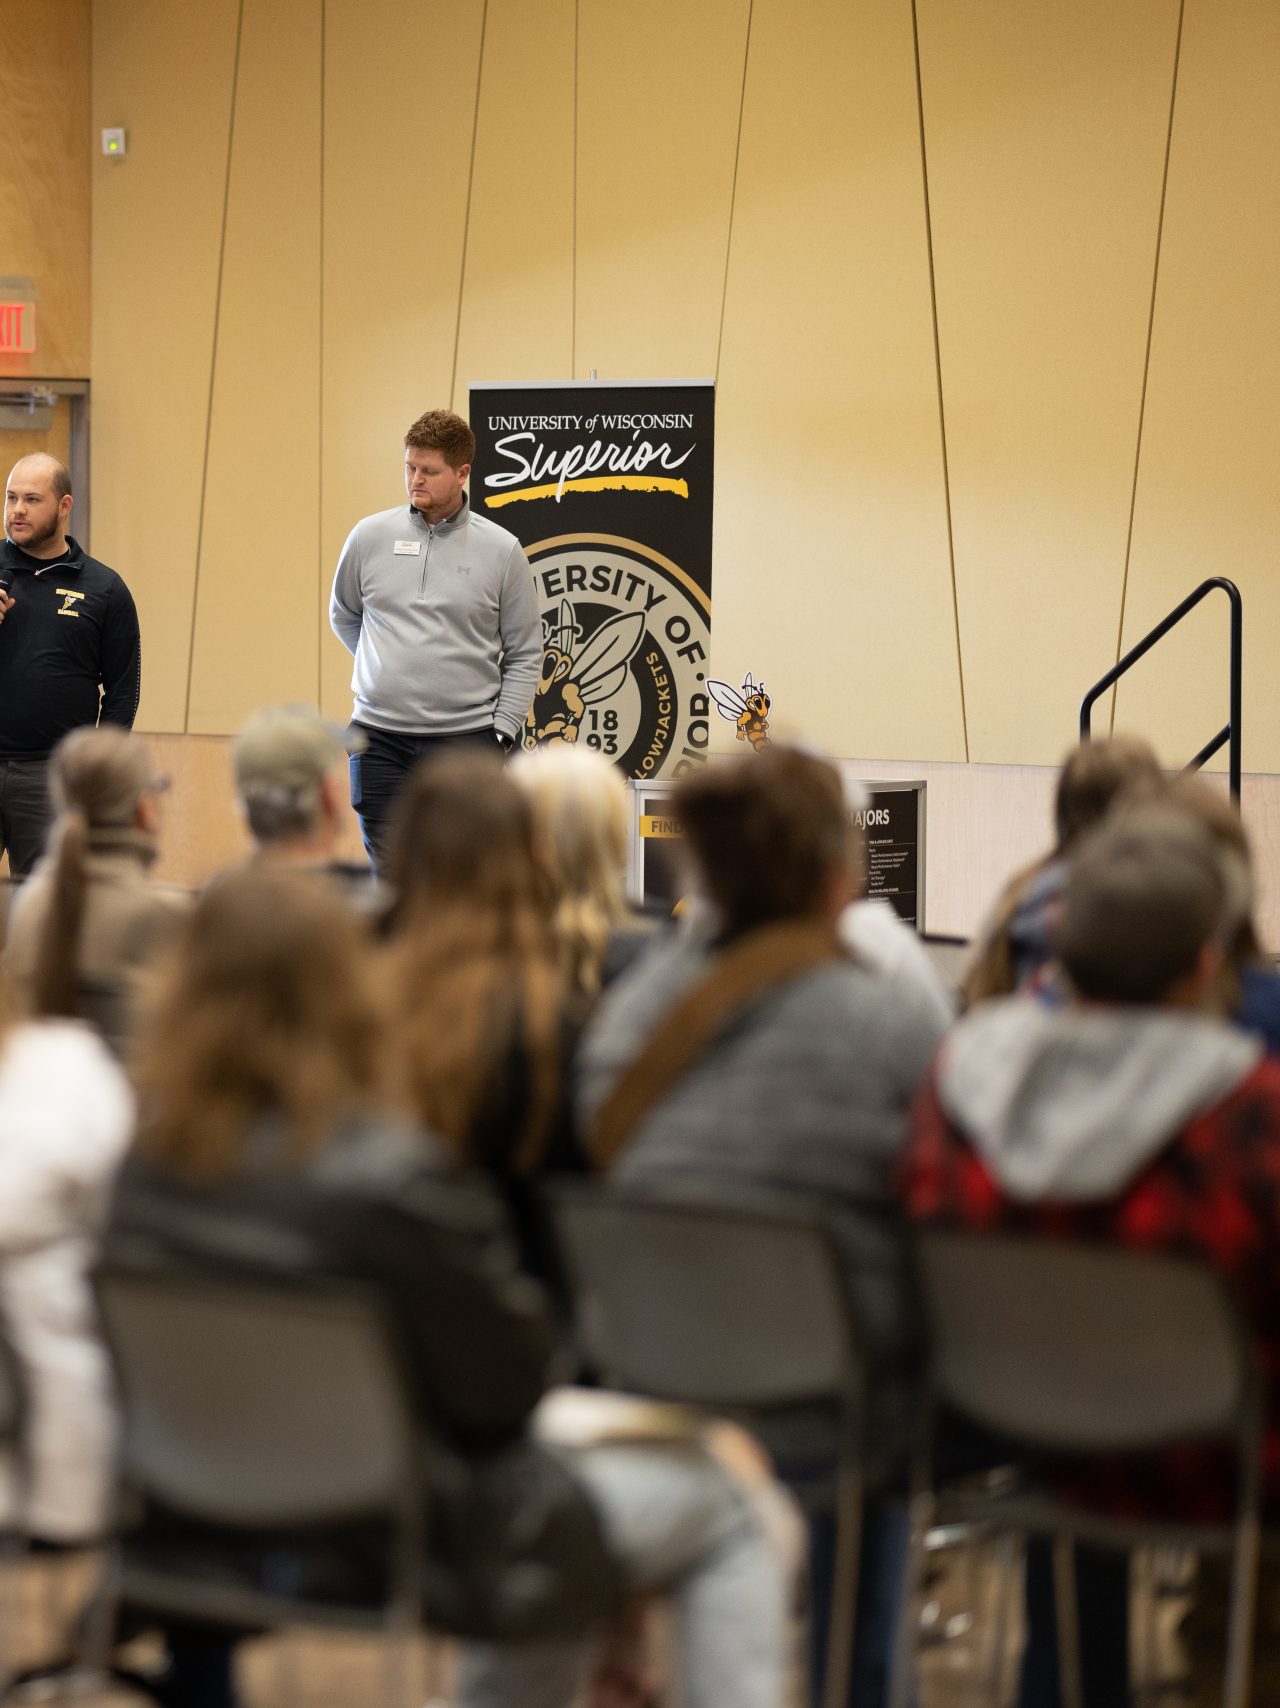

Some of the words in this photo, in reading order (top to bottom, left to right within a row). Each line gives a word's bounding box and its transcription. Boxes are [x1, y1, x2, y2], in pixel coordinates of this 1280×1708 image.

[487, 415, 583, 431] UNIVERSITY
[585, 413, 600, 433] of
[602, 413, 694, 429] WISCONSIN
[483, 429, 697, 504] Superior
[533, 564, 668, 612] ERSITY
[664, 615, 707, 665] OF
[588, 709, 619, 732] 18
[634, 651, 672, 779] LOWJACKETS
[586, 733, 619, 756] 93
